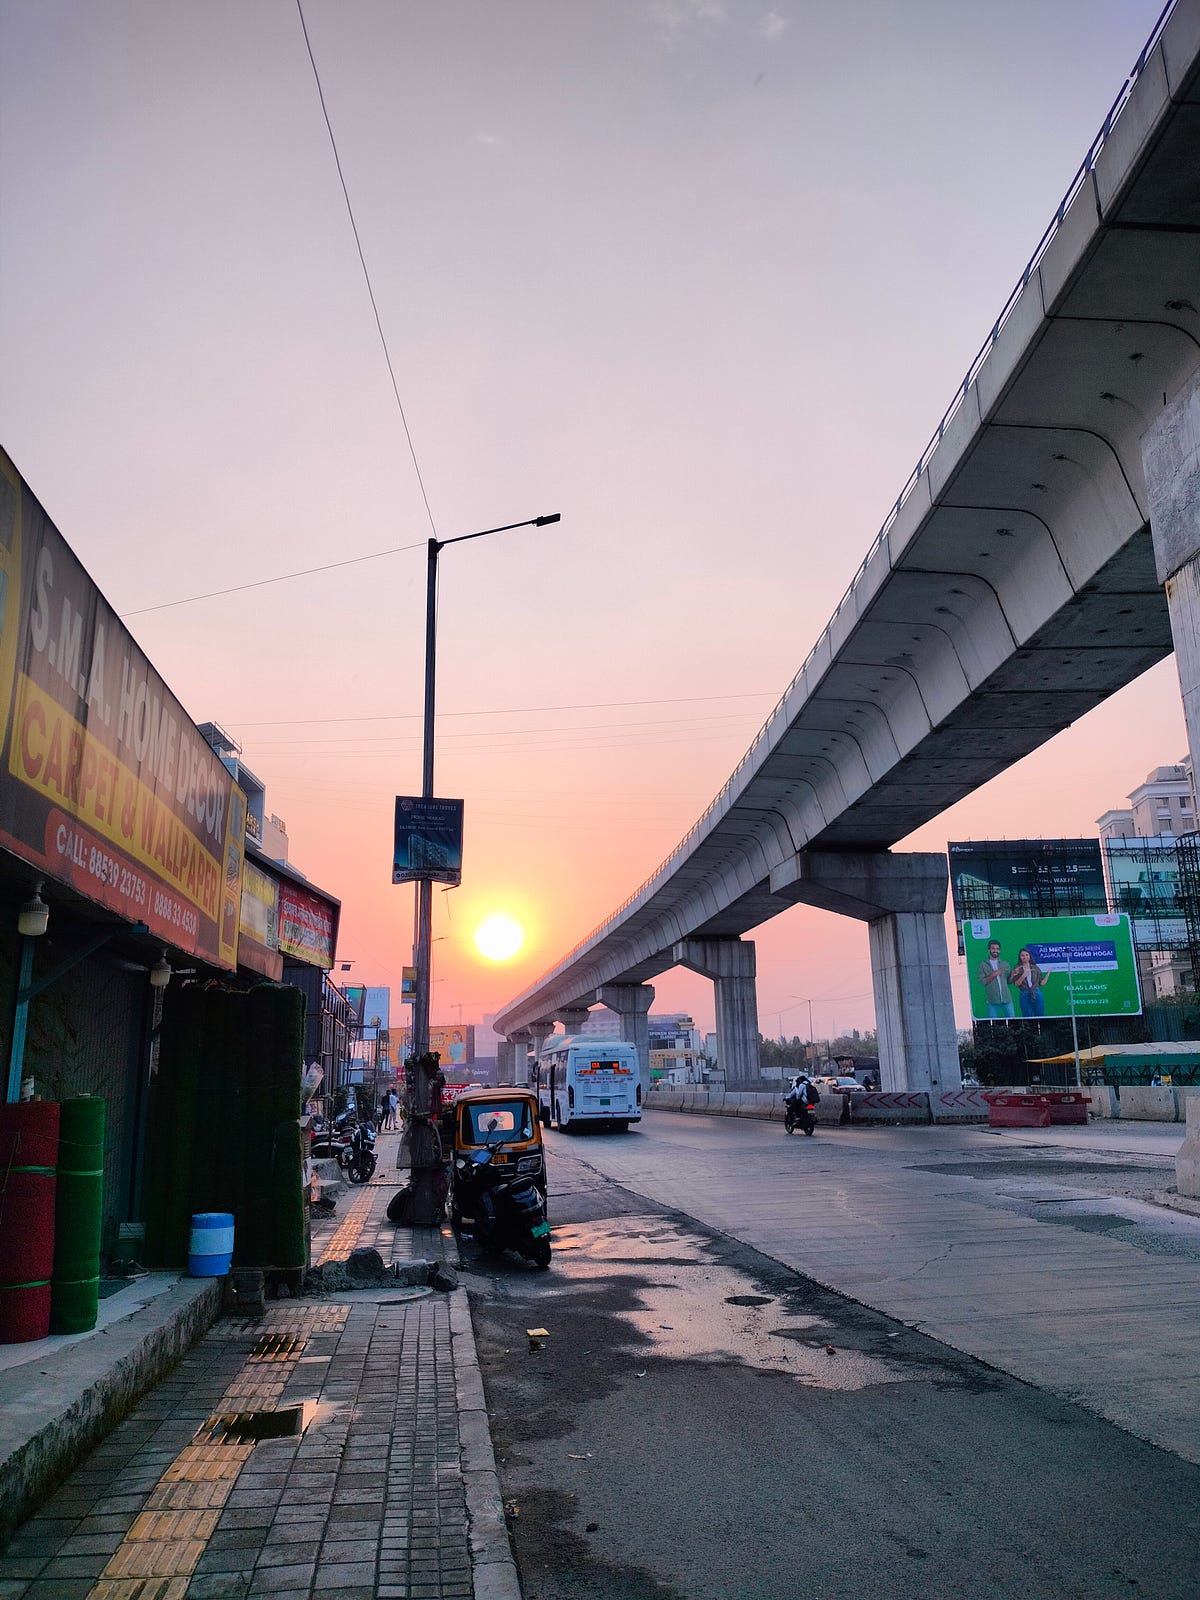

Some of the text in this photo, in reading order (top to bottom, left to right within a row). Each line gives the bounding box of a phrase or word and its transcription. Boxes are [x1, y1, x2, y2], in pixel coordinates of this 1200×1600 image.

[31, 546, 225, 845] S.M.A. HOME DECOR
[21, 701, 218, 919] CARPET & WALLPAPER
[56, 823, 87, 869] CALL:
[89, 846, 119, 888] 88539
[120, 868, 146, 905] 23753
[154, 891, 172, 921] 8888
[172, 902, 181, 926] 33
